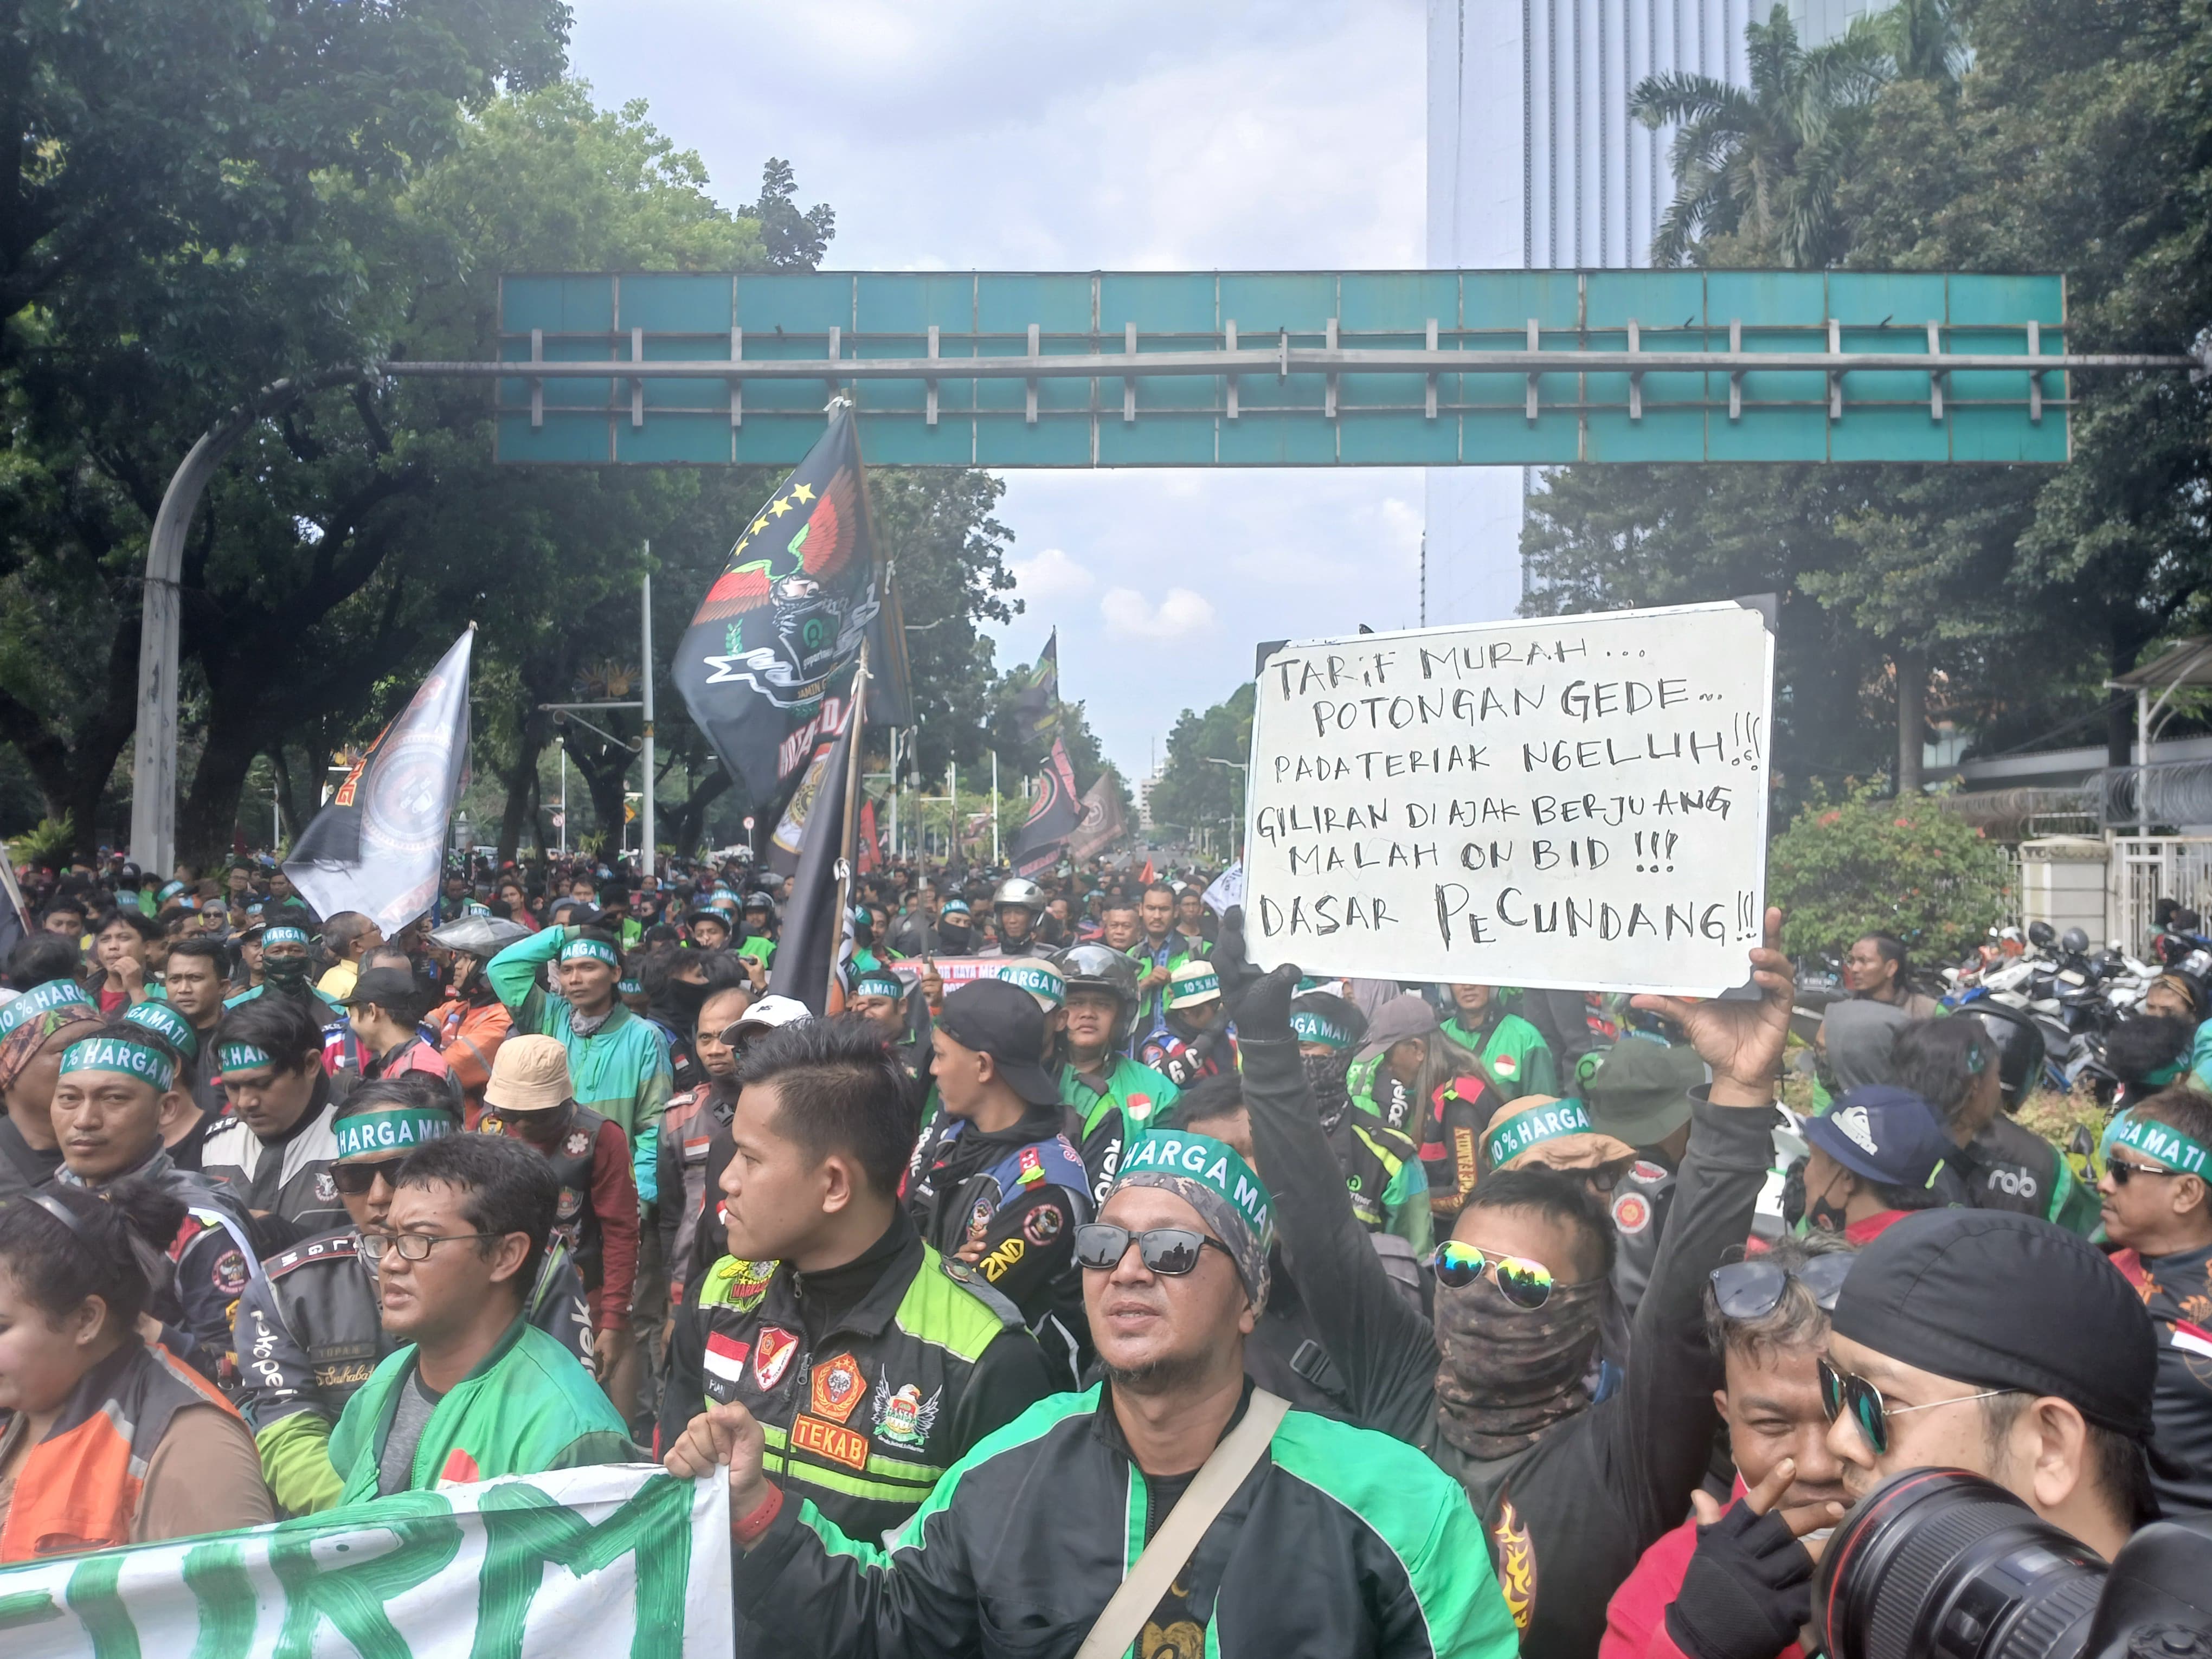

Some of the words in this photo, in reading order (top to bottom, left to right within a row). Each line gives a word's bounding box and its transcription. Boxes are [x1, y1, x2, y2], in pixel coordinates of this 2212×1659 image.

[1312, 685, 1545, 737] POTONGAN
[1257, 798, 1388, 847] GILIRAN
[1532, 785, 1732, 826] BERJUANG
[1289, 841, 1438, 876] MALAH
[1461, 840, 1513, 871] ON
[1532, 835, 1609, 871] BID
[266, 929, 299, 941] HARGA
[1259, 894, 1399, 937] DASAR
[874, 983, 897, 996] MATI
[1001, 970, 1050, 992] HARGA
[147, 1010, 188, 1046] MATI
[83, 1044, 160, 1080] HARGA
[342, 1119, 415, 1155] HARGA
[1516, 1107, 1589, 1145] HARGA
[1119, 1139, 1229, 1190] HARGA
[1455, 1128, 1475, 1174] FAMILY
[2142, 1128, 2206, 1173] MATI
[980, 1238, 1025, 1283] 2ND
[318, 1346, 361, 1358] TOPAN
[798, 1420, 863, 1461] TEKAB
